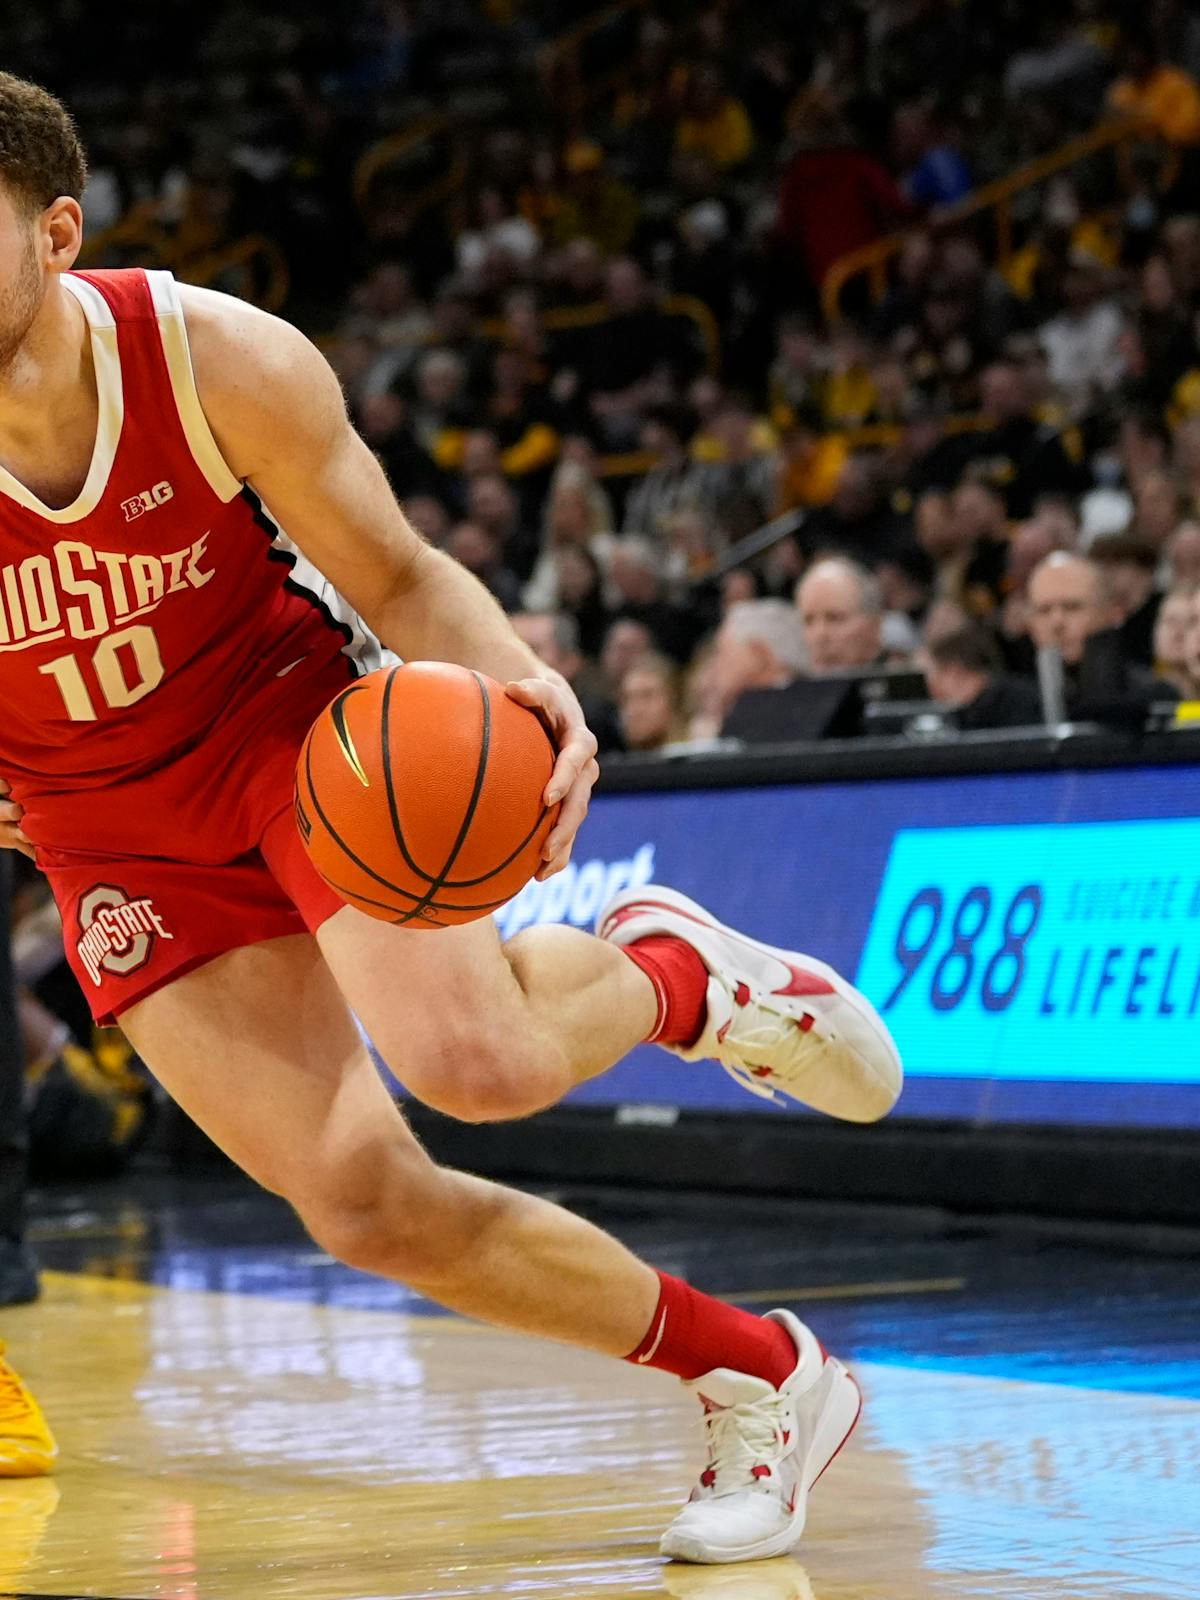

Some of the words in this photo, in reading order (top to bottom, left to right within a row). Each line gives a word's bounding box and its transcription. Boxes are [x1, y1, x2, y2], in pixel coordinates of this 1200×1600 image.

[38, 624, 165, 722] 10
[493, 842, 656, 943] pport
[880, 883, 1042, 1013] 988
